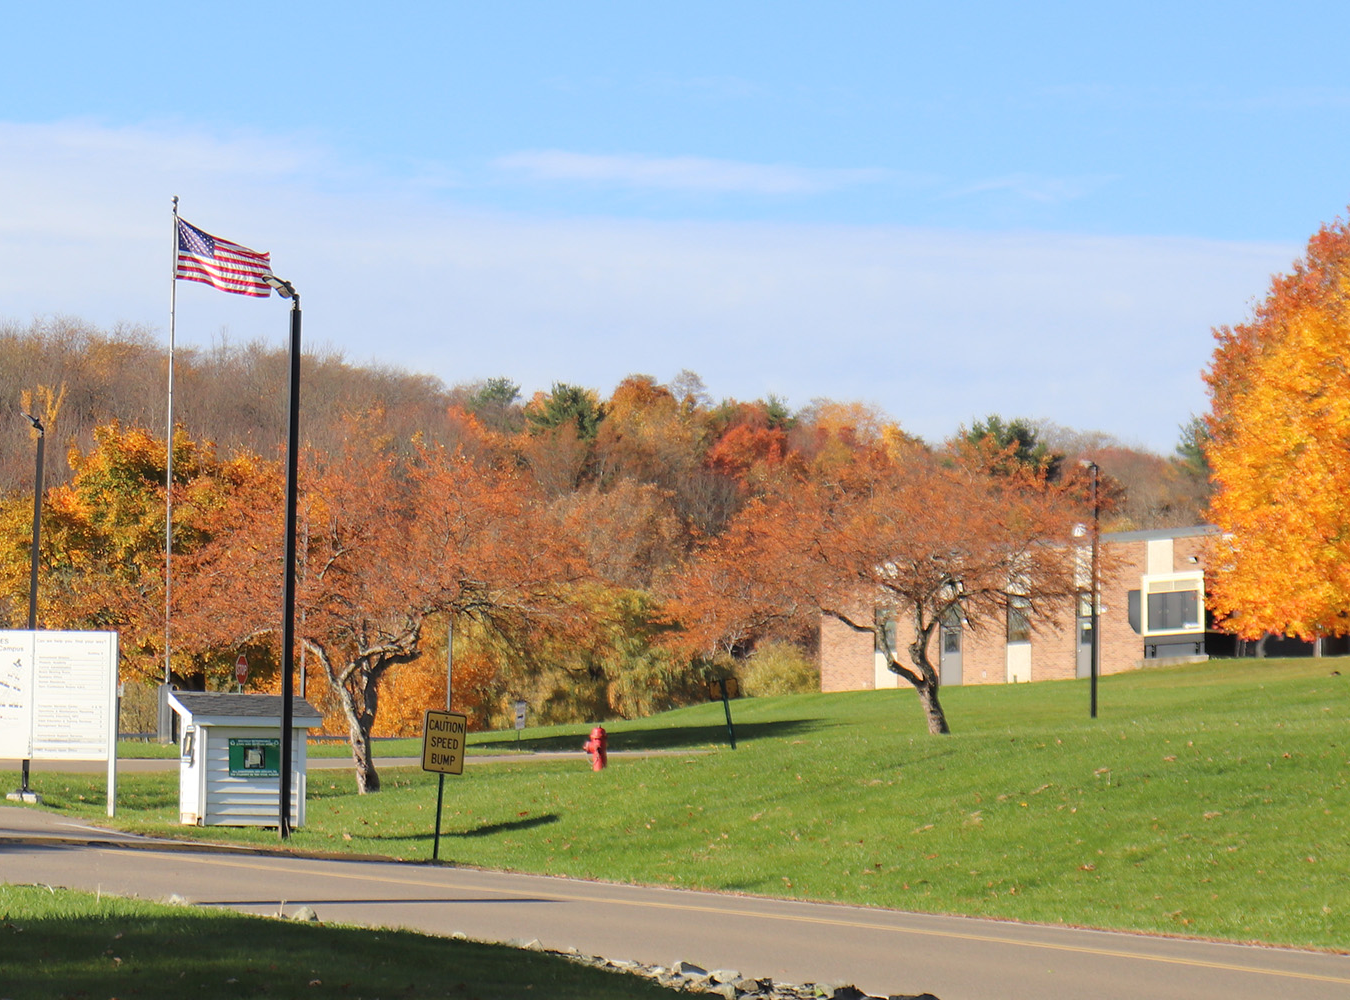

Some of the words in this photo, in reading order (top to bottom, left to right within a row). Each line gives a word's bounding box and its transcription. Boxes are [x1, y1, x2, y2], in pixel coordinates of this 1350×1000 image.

[429, 719, 464, 734] CAUTION
[430, 736, 459, 750] SPEED
[431, 752, 456, 766] BUMP
